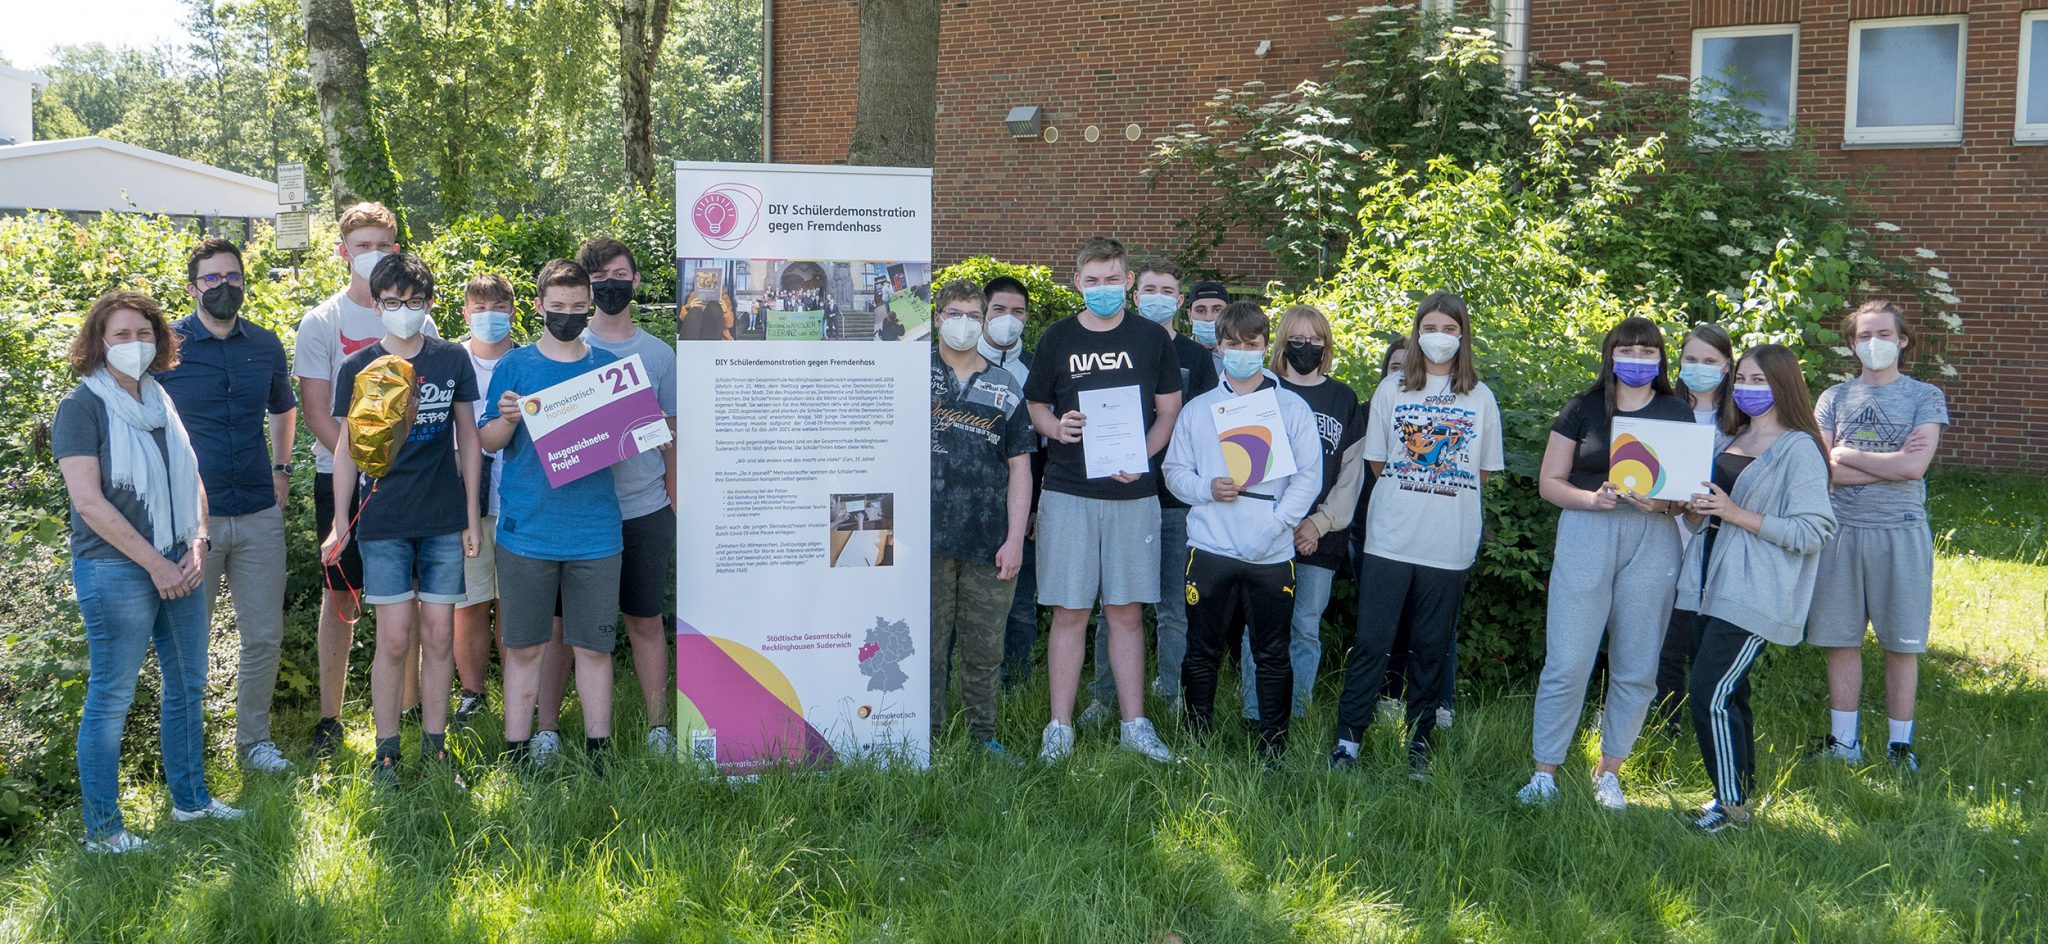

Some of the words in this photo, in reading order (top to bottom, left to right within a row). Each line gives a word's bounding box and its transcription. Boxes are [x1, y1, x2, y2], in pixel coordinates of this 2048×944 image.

[768, 204, 788, 216] DIY
[792, 204, 916, 218] Schülerdemonstration
[768, 222, 804, 234] gegen
[807, 220, 882, 232] Fremdenhass
[1069, 352, 1134, 372] NASA
[598, 362, 640, 394] '21
[544, 387, 596, 412] demokratisch
[546, 402, 578, 420] handeln
[548, 432, 610, 462] Ausgezeichnetes
[552, 455, 580, 472] Projekt
[1460, 454, 1469, 463] 15
[766, 634, 802, 642] Städtische
[804, 632, 852, 640] Gesamtschule
[762, 642, 815, 651] Recklinghausen
[816, 641, 852, 649] Suderwich
[872, 712, 916, 720] demokratisch
